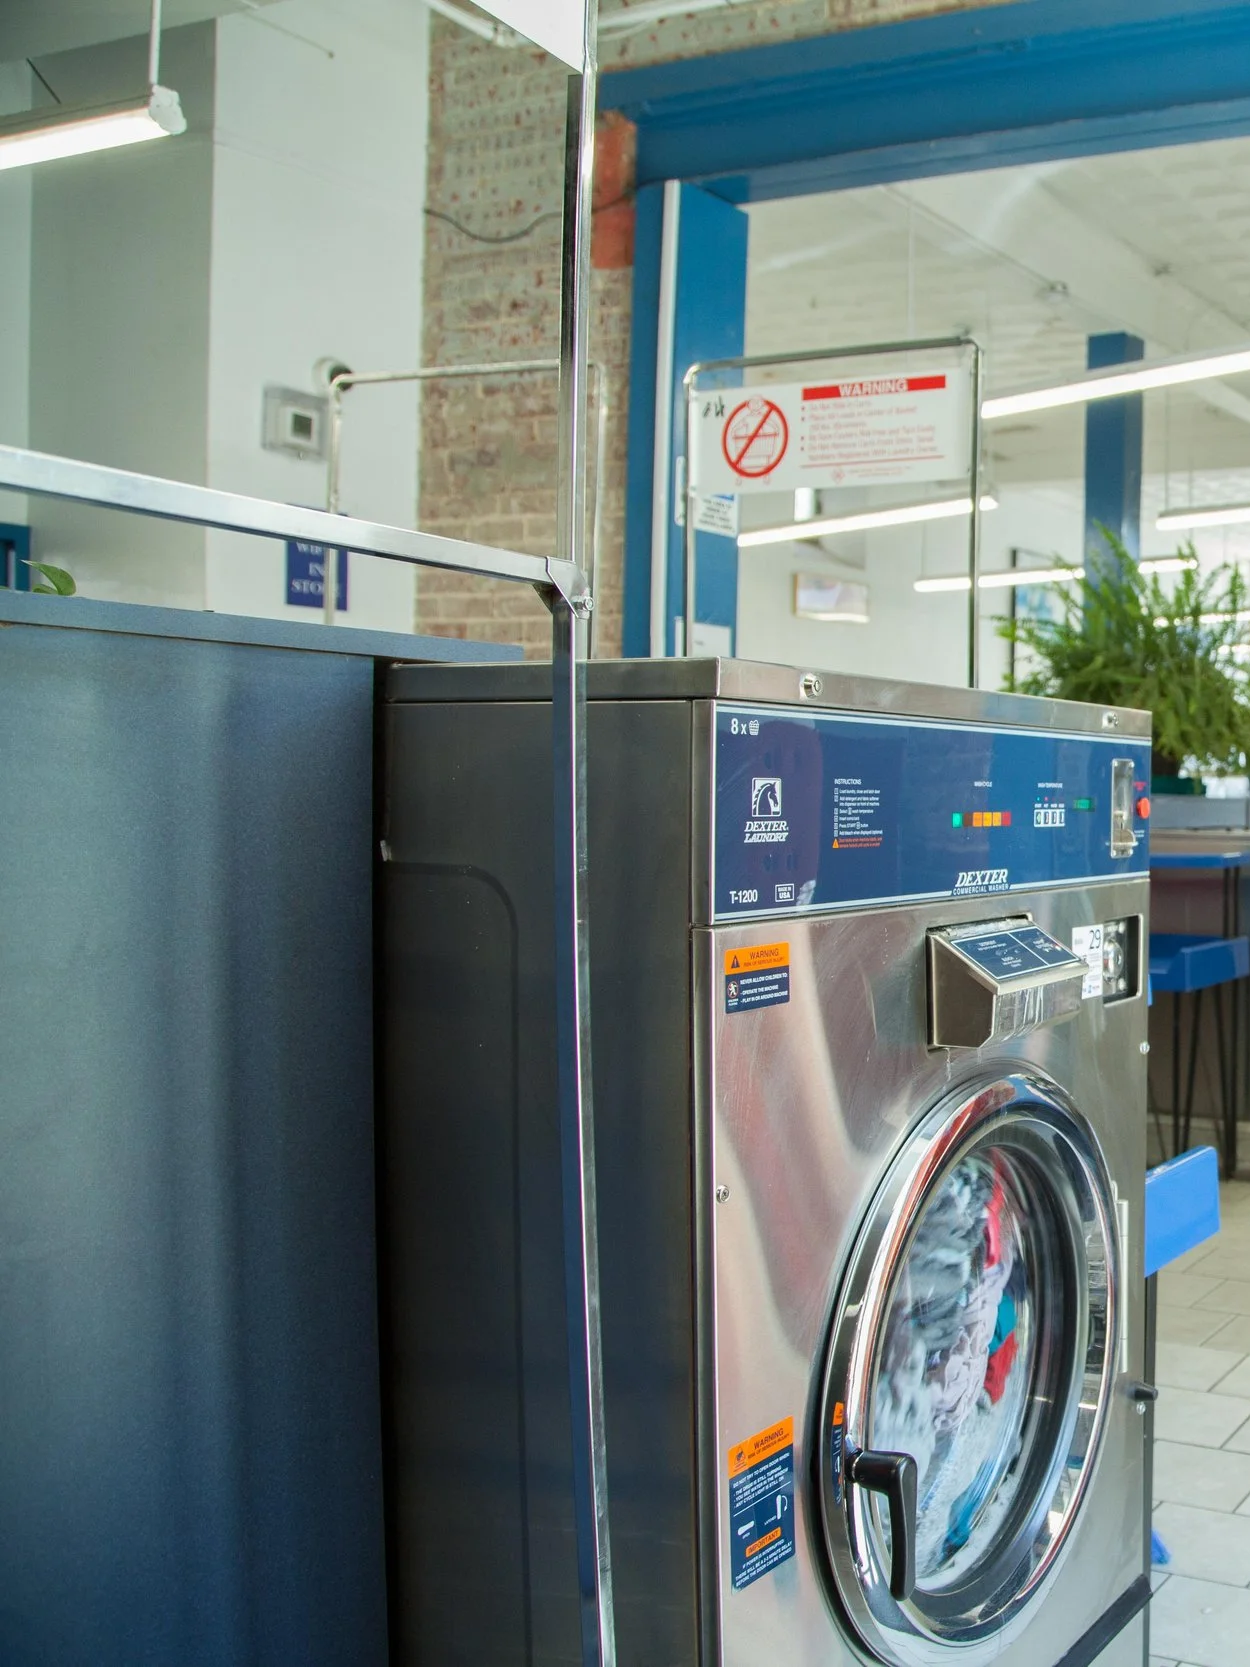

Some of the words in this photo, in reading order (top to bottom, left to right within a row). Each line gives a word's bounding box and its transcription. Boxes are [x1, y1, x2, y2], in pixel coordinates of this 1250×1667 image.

[839, 378, 907, 397] WARNING
[731, 718, 739, 735] 8
[740, 724, 747, 734] x
[744, 820, 788, 832] DEXTER
[744, 832, 788, 843] LAUNDRY
[954, 868, 1008, 887] DEXTER
[729, 889, 758, 904] T-1200
[953, 886, 987, 895] COMMERCIAL
[988, 883, 1008, 892] WASHER
[1089, 929, 1101, 950] 29
[750, 948, 779, 959] WARNING
[754, 1428, 784, 1450] WARNING
[759, 1464, 769, 1472] OPEN
[769, 1458, 779, 1467] DOOR
[766, 1465, 782, 1477] TURNING
[751, 1482, 763, 1492] WATER
[774, 1467, 788, 1478] WINDOW
[744, 1493, 755, 1503] CYCLE
[755, 1487, 765, 1496] LIGHT
[749, 1531, 779, 1553] IMPORTANT
[736, 1570, 746, 1581] THERE
[747, 1565, 755, 1573] WILL
[769, 1548, 781, 1558] MINUTE
[781, 1540, 792, 1550] DELAY
[736, 1575, 750, 1587] BEFORE
[757, 1564, 766, 1573] DOOR
[779, 1547, 792, 1558] OPENED
[746, 1556, 758, 1566] POWER
